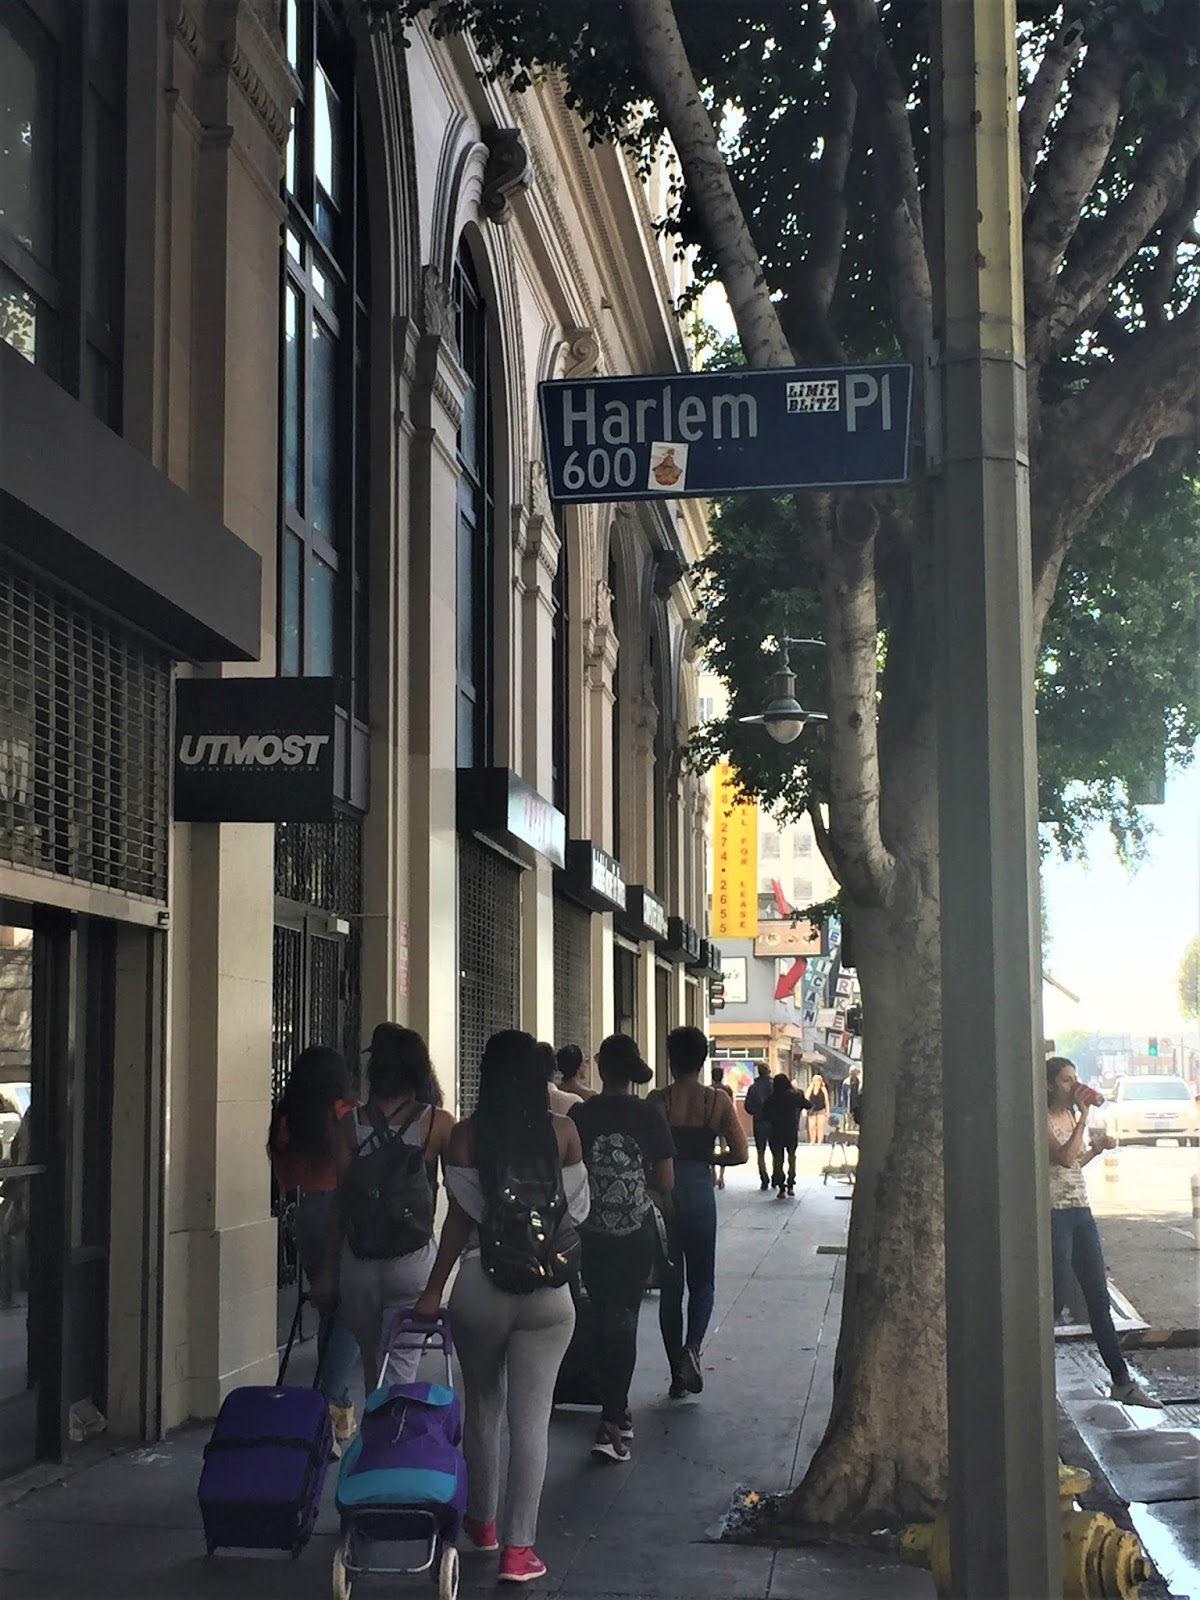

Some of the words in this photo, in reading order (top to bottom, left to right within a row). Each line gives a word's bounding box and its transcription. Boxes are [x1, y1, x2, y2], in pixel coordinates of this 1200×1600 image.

[562, 384, 758, 447] Harlem
[845, 373, 892, 432] Pl
[562, 447, 637, 490] 600
[179, 735, 330, 765] UTMOST
[740, 881, 748, 928] LEASE
